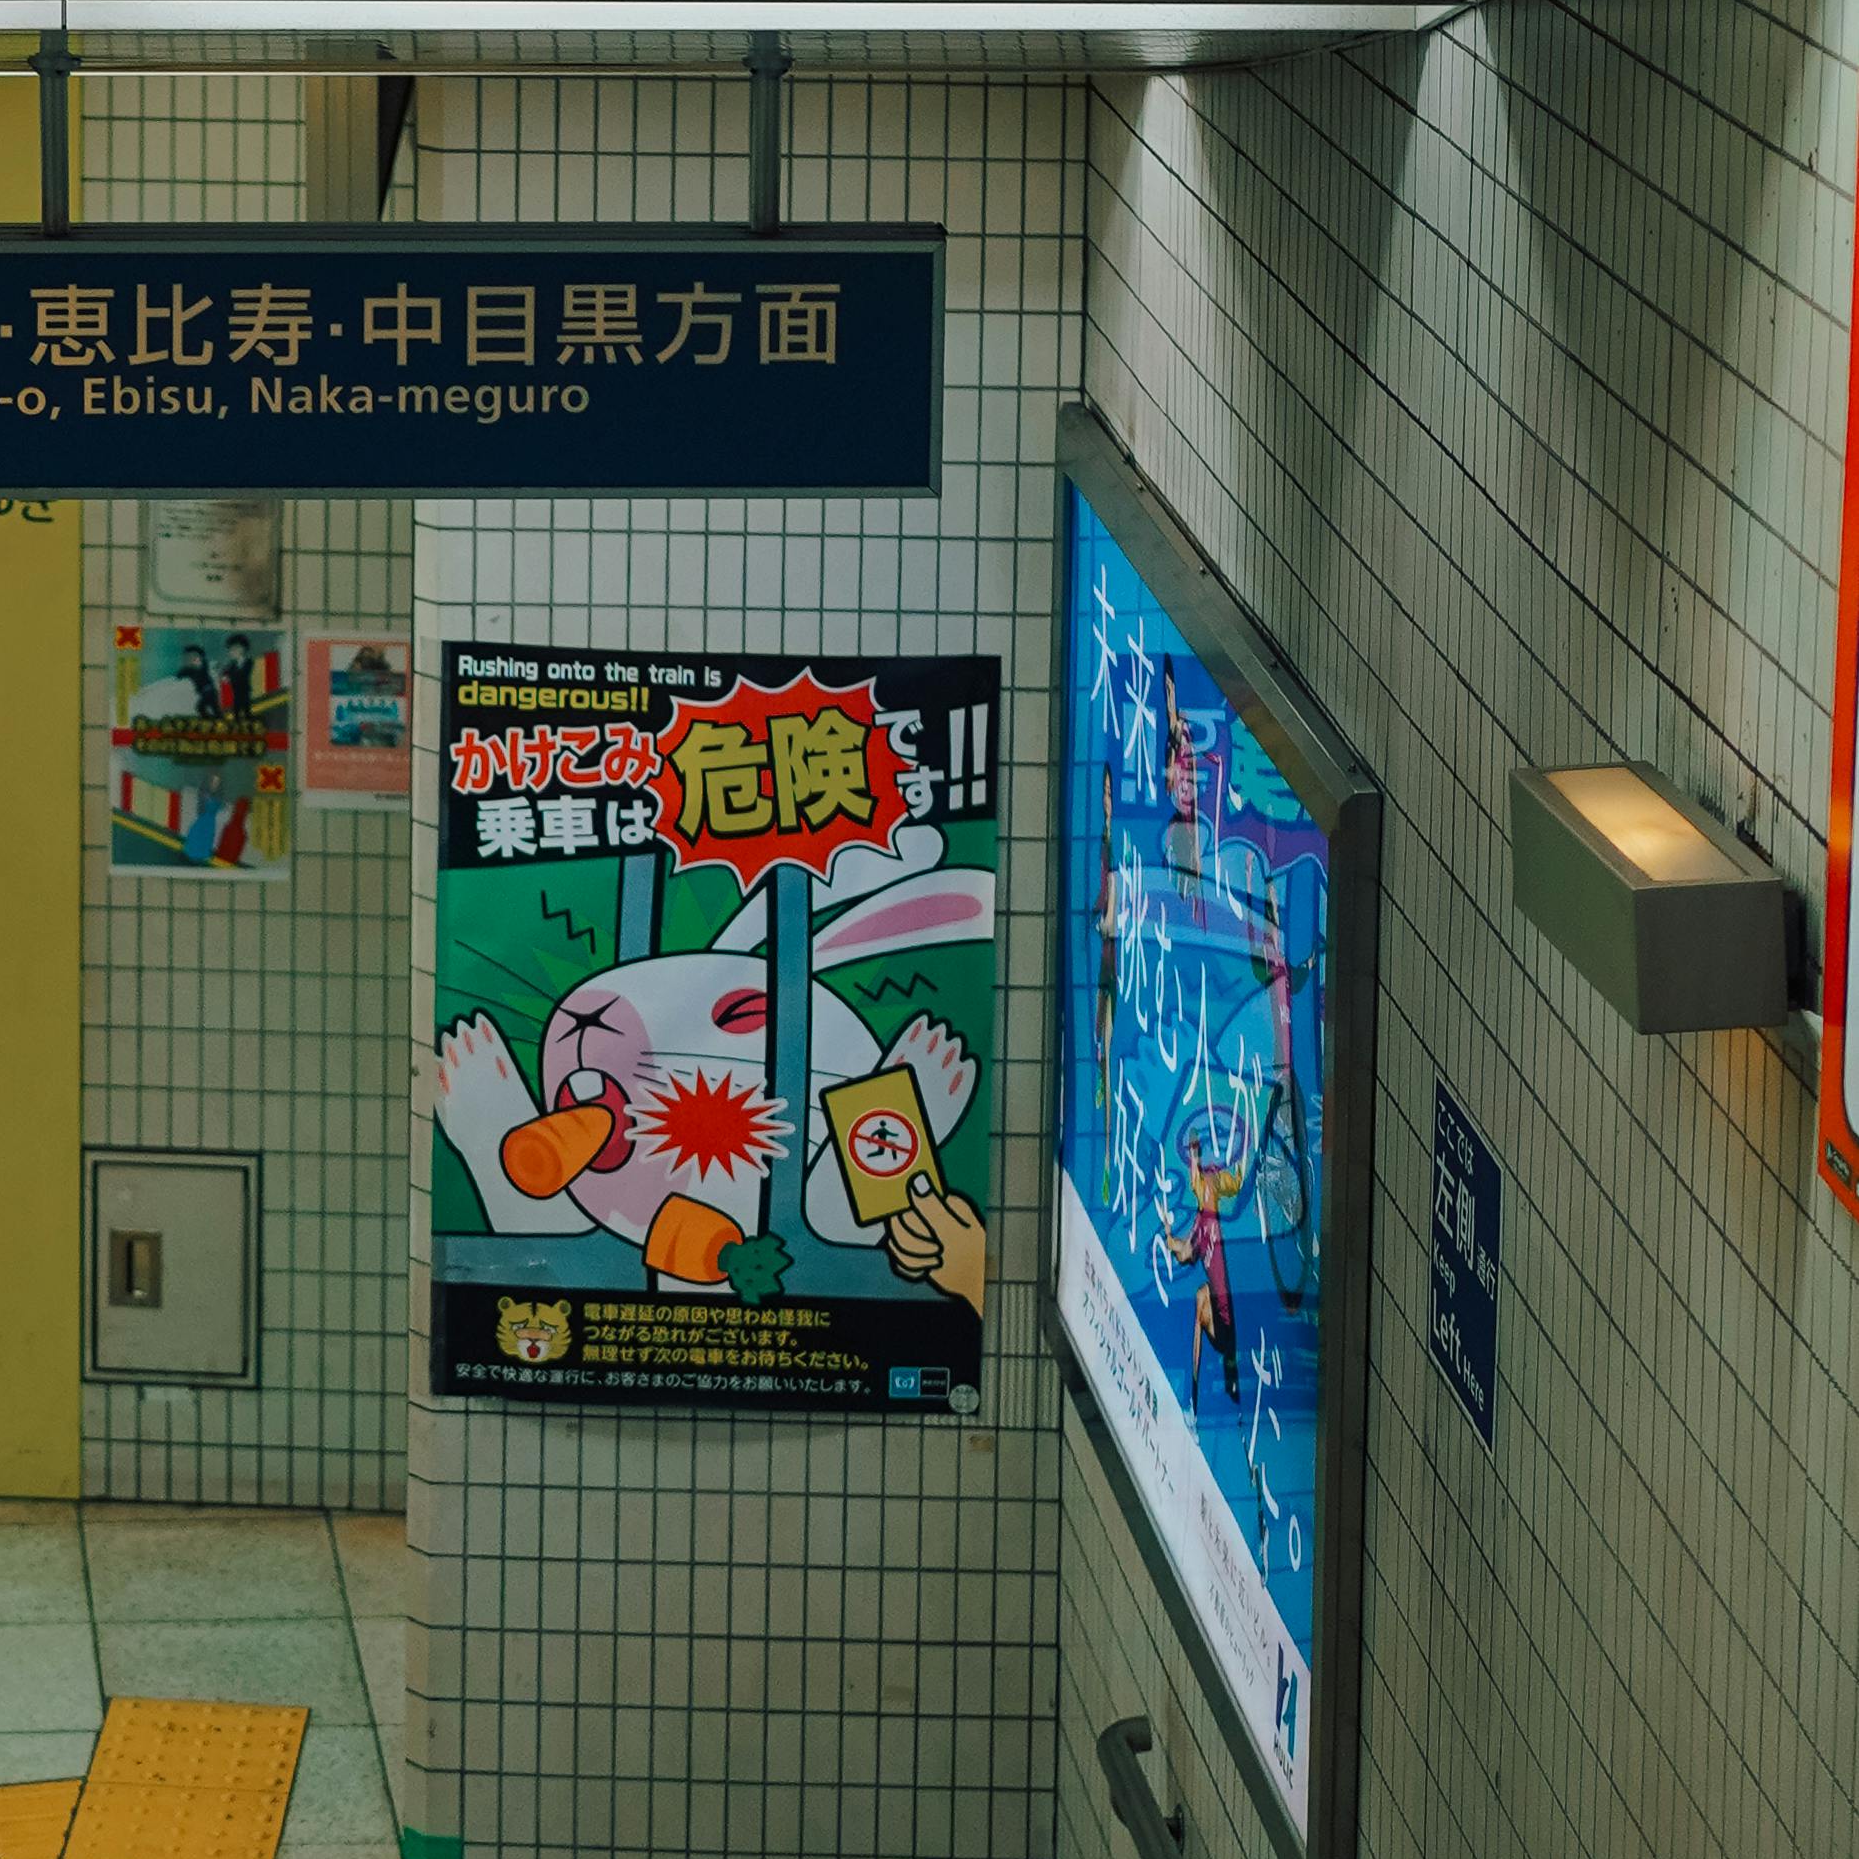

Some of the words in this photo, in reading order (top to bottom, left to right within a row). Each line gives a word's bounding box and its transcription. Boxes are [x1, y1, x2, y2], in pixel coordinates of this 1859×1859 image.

[83, 375, 228, 420] Ebisu,
[251, 374, 590, 424] Naka-meguro
[458, 655, 538, 681] Rushing
[547, 661, 595, 680] onto
[604, 662, 639, 683] the
[648, 663, 695, 686] train
[704, 667, 722, 687] is
[458, 681, 649, 712] dangerous!!
[449, 721, 662, 795] かけこみ
[670, 707, 879, 844] 危険
[476, 795, 655, 858] 乗車は
[1437, 1100, 1476, 1177] ここでは
[1433, 1238, 1456, 1299] Keep
[1433, 1288, 1462, 1378] Left
[1463, 1354, 1484, 1413] Here
